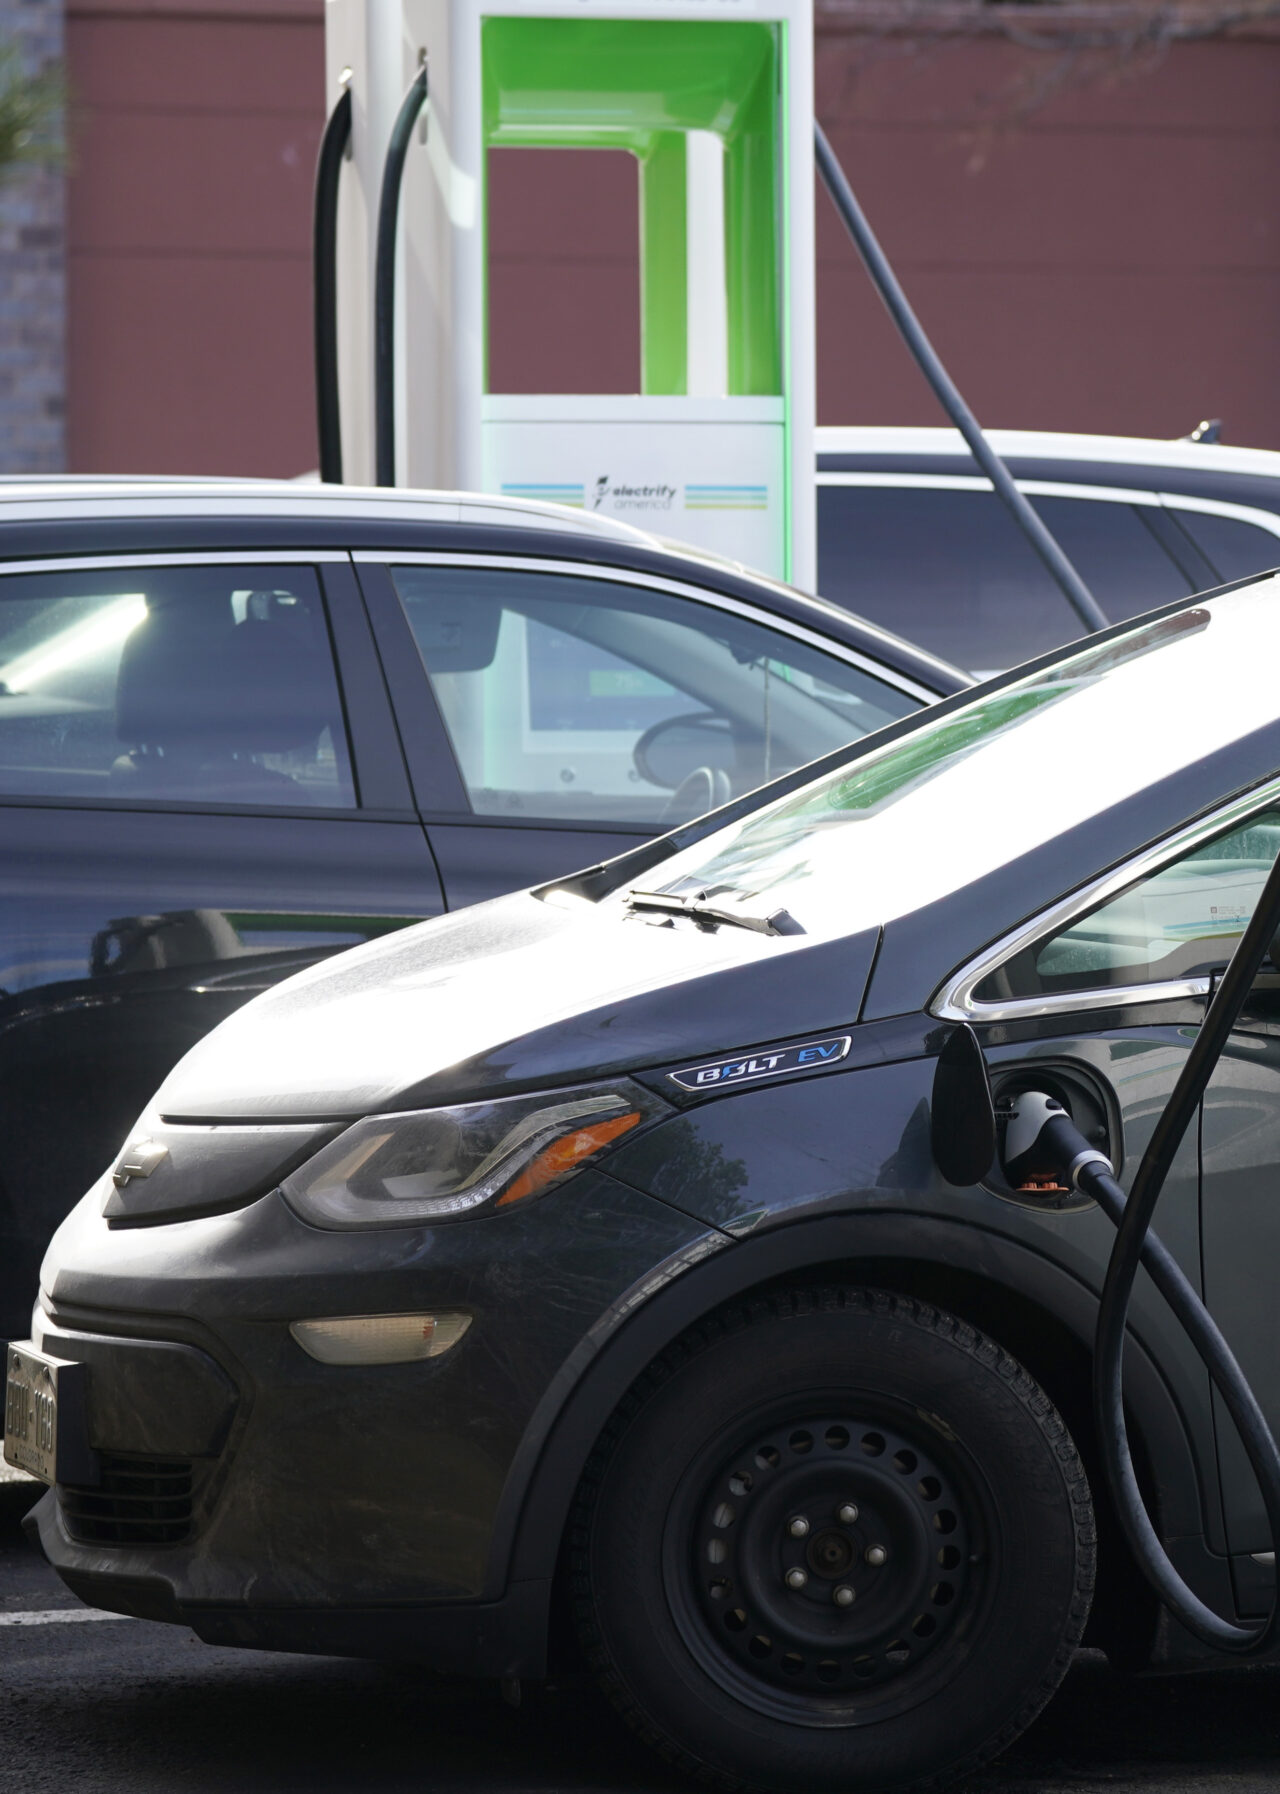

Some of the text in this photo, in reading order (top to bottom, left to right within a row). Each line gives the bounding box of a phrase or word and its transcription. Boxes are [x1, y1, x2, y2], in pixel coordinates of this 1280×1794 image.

[613, 484, 676, 501] electrify
[614, 499, 671, 511] america
[697, 1043, 838, 1084] BOLT EV
